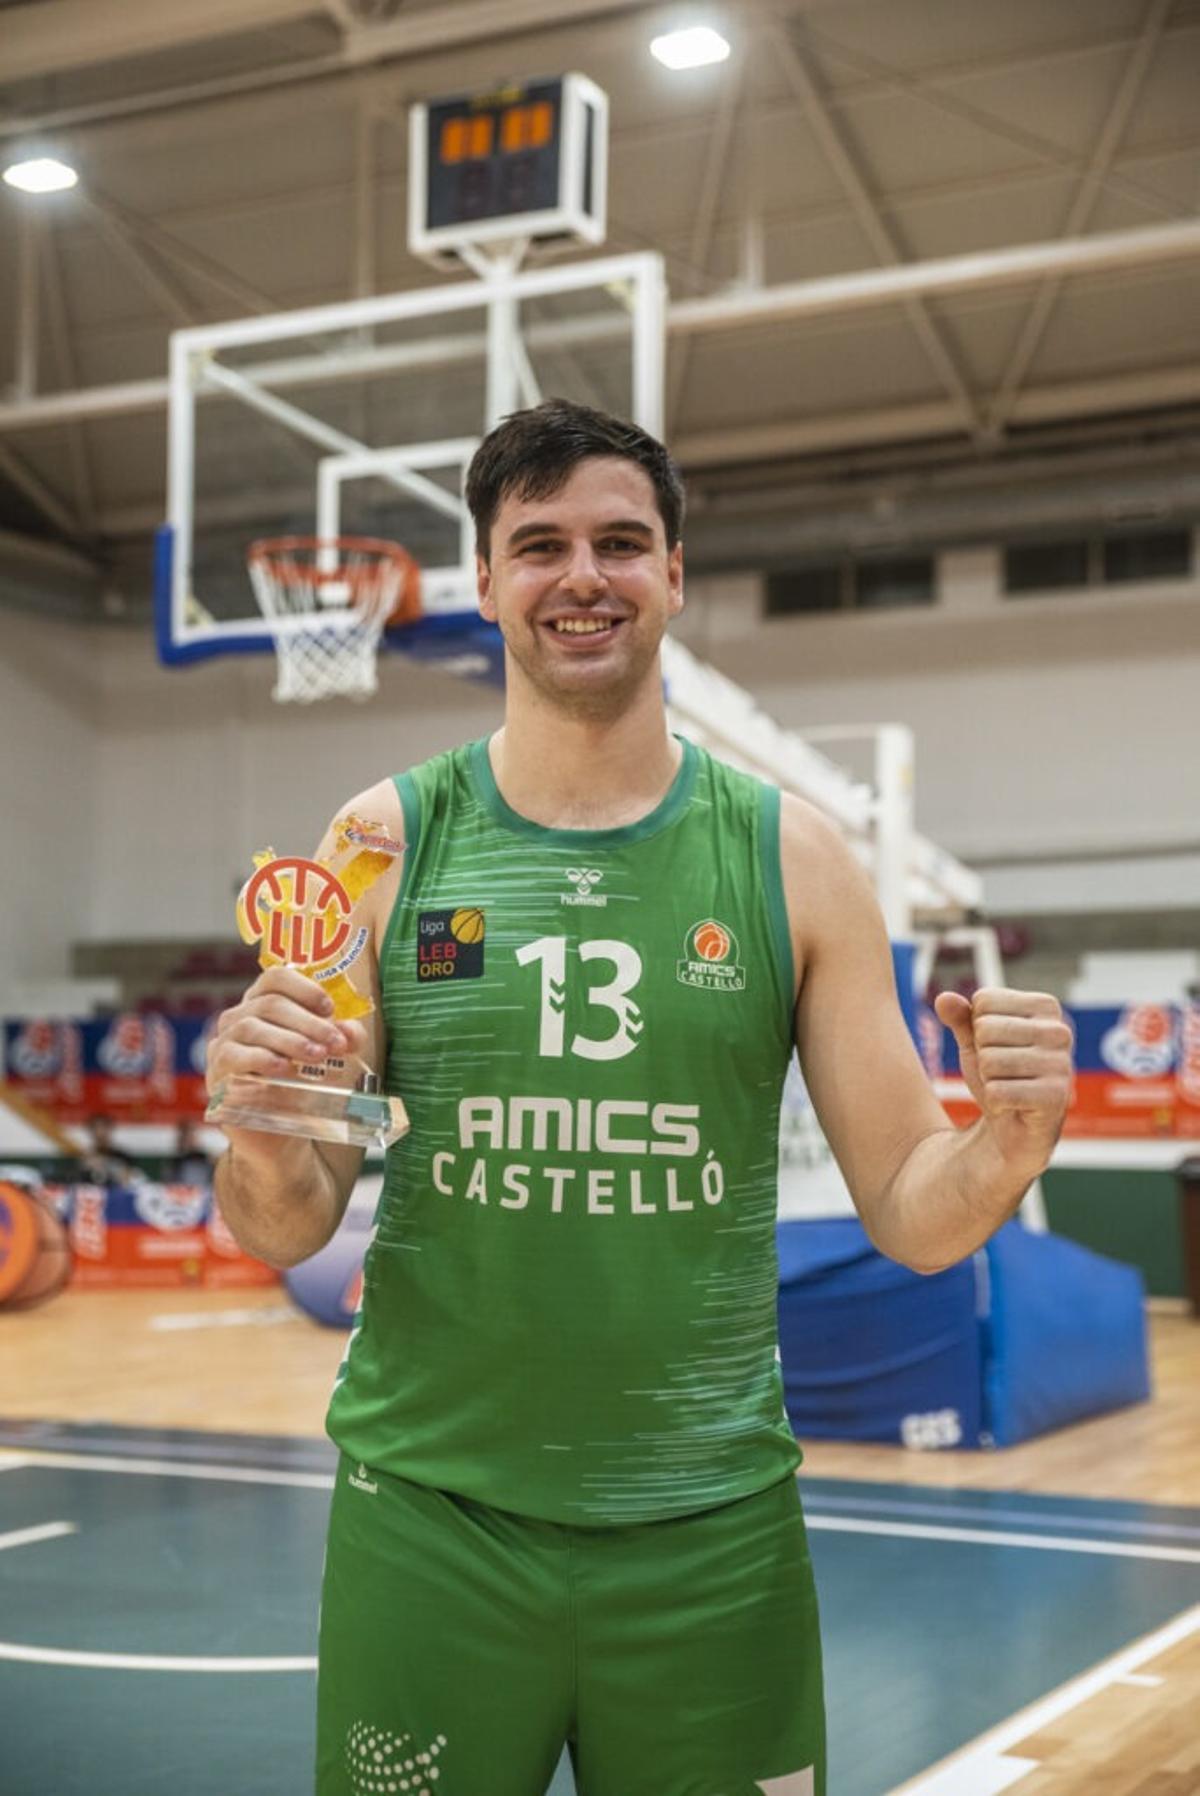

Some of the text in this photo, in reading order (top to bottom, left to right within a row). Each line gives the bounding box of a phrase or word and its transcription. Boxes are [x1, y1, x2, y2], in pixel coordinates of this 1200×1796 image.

[420, 919, 445, 936] Liga
[420, 943, 457, 962] LEB
[420, 960, 455, 977] ORO
[688, 960, 736, 978] AMICS
[515, 936, 644, 1061] 13
[458, 1096, 700, 1157] AMICS
[432, 1149, 725, 1215] CASTELLÓ
